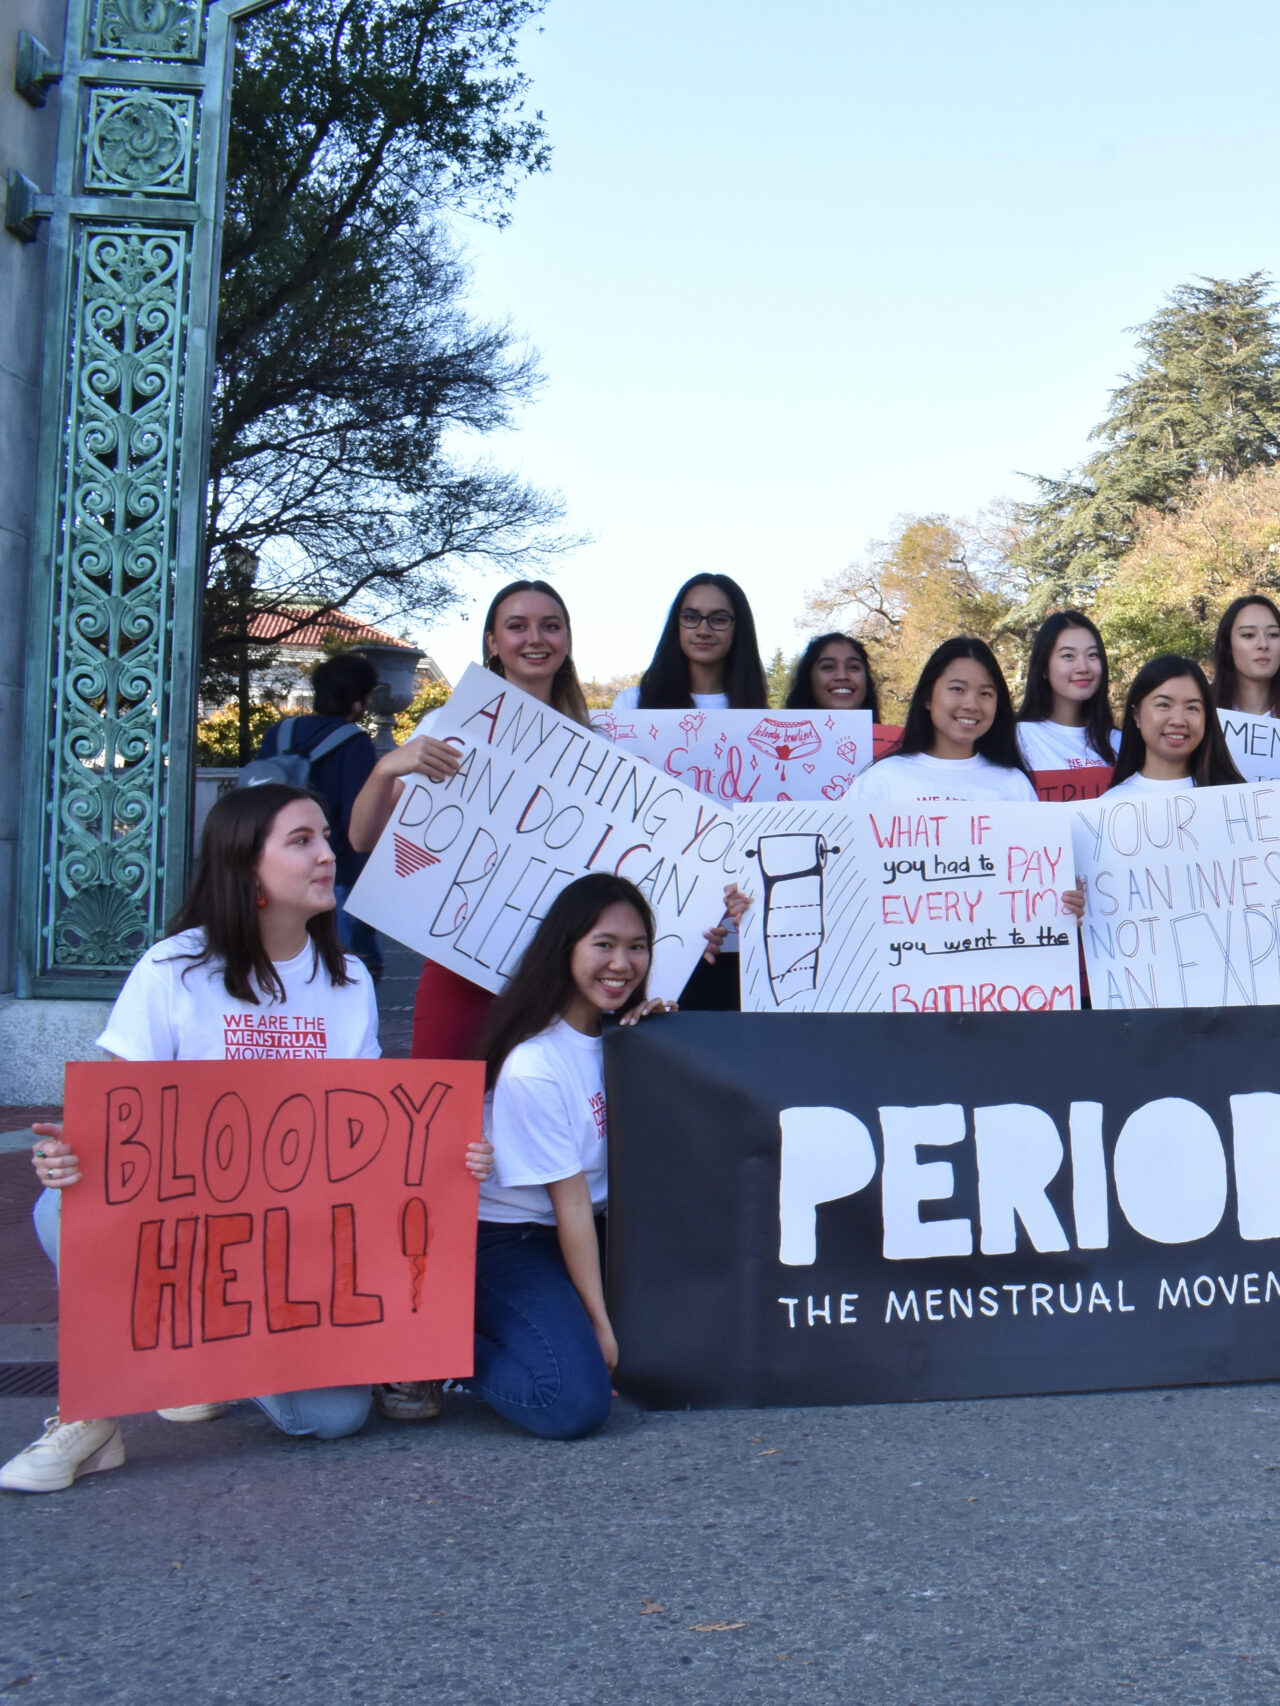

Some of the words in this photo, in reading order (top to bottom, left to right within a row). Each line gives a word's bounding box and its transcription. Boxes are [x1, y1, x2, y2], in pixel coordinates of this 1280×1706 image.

[461, 691, 684, 841] ANYTHING
[399, 784, 464, 852] DO
[869, 813, 948, 848] WHAT
[971, 815, 992, 845] IF
[1076, 795, 1199, 862] YOUR
[517, 784, 584, 849] DO
[584, 823, 614, 871] I
[615, 843, 700, 917] CAN
[882, 858, 926, 884] you
[934, 854, 970, 874] had
[979, 854, 994, 872] to
[1007, 846, 1062, 888] PAY
[882, 890, 983, 924] EVERY
[1128, 864, 1173, 912] AN
[889, 939, 926, 966] you
[944, 928, 997, 952] went
[1008, 927, 1026, 945] to
[1036, 925, 1070, 946] the
[1089, 916, 1161, 959] NOT
[892, 983, 1075, 1012] BATHROOM
[1107, 964, 1159, 1009] AN
[223, 1014, 254, 1028] WE
[257, 1015, 289, 1030] ARE
[292, 1016, 326, 1031] THE
[226, 1031, 326, 1047] MENSTRUAL
[225, 1047, 328, 1060] MOVEMENT
[105, 1081, 454, 1205] BLOODY
[778, 1293, 860, 1329] THE
[885, 1281, 1136, 1323] MENSTRUAL
